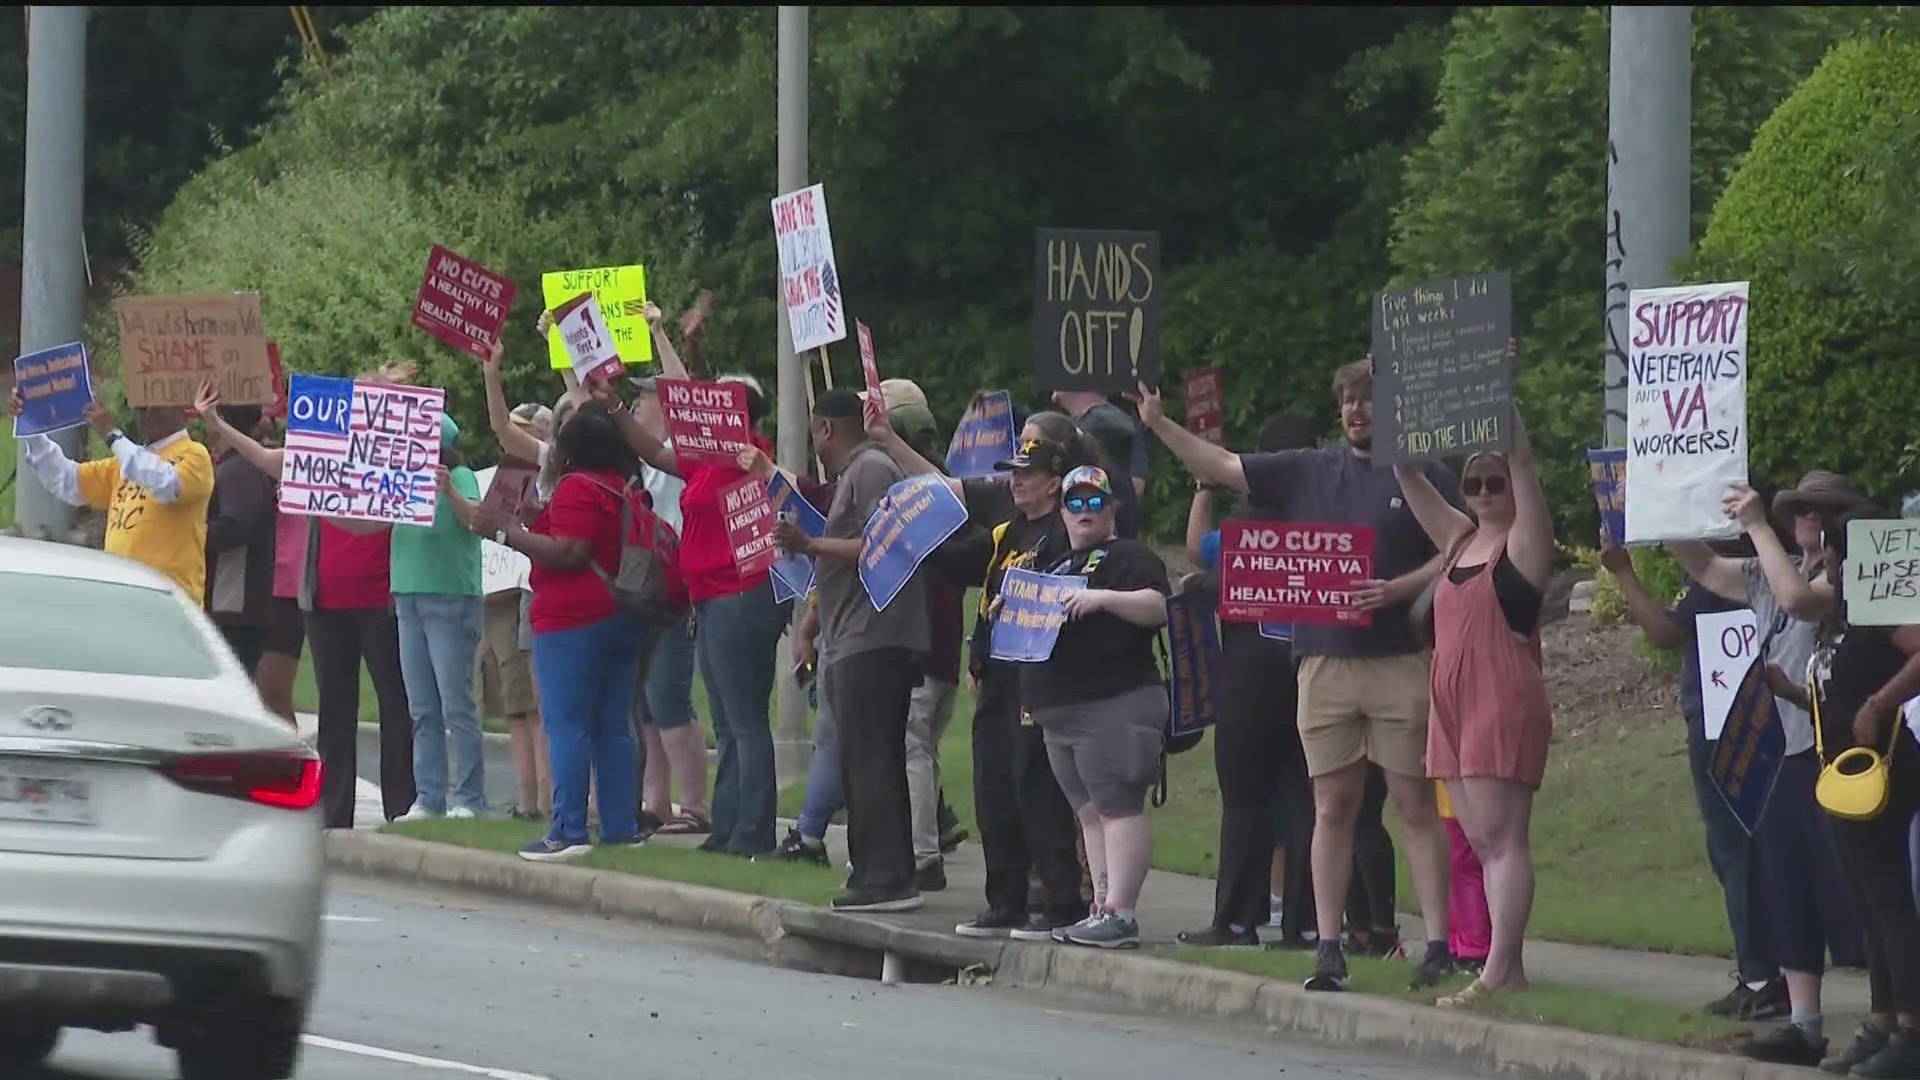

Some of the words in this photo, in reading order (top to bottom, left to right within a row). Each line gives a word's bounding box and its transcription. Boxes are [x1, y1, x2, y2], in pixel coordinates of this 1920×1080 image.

[796, 190, 815, 226] THE
[437, 256, 460, 278] NO
[461, 268, 503, 298] CUTS
[563, 269, 619, 290] SUPPORT
[1048, 239, 1153, 302] HANDS
[428, 275, 436, 288] A
[437, 279, 484, 310] HEALTHY
[485, 302, 499, 318] VA
[1382, 293, 1407, 311] Five
[1413, 287, 1445, 306] things
[1453, 280, 1458, 300] I
[1470, 277, 1487, 296] did
[420, 300, 464, 328] HEALTHY
[465, 322, 491, 341] VETS
[615, 327, 632, 341] THE
[1633, 295, 1746, 348] SUPPORT
[137, 338, 215, 371] SHAME
[1060, 307, 1144, 377] OFF!
[1632, 350, 1740, 385] VETERANS
[294, 395, 348, 431] OUR
[667, 385, 690, 403] NO
[692, 388, 734, 408] CUTS
[1635, 389, 1660, 404] AND
[1663, 382, 1708, 431] VA
[363, 391, 436, 436] VETS
[669, 408, 677, 419] A
[678, 409, 722, 424] HEALTHY
[726, 413, 742, 427] VA
[674, 434, 719, 452] HEALTHY
[1434, 424, 1457, 450] THE
[1462, 415, 1498, 446] LINE!
[1633, 426, 1739, 457] WORKERS!
[349, 432, 428, 472] NEED
[292, 454, 355, 489] MORE
[361, 471, 431, 502] CARE
[308, 492, 358, 512] NOT
[367, 495, 417, 519] LESS
[726, 490, 740, 512] NO
[740, 480, 761, 502] CUTS
[730, 518, 736, 532] A
[735, 508, 761, 529] HEALTHY
[762, 502, 770, 515] VA
[736, 539, 764, 560] HEALTHY
[1239, 529, 1280, 550] NO
[1284, 531, 1353, 552] CUTS
[1232, 555, 1245, 569] A
[1250, 556, 1333, 573] HEALTHY
[1338, 559, 1362, 575] VA
[1229, 586, 1312, 604] HEALTHY
[1870, 579, 1918, 601] LIES
